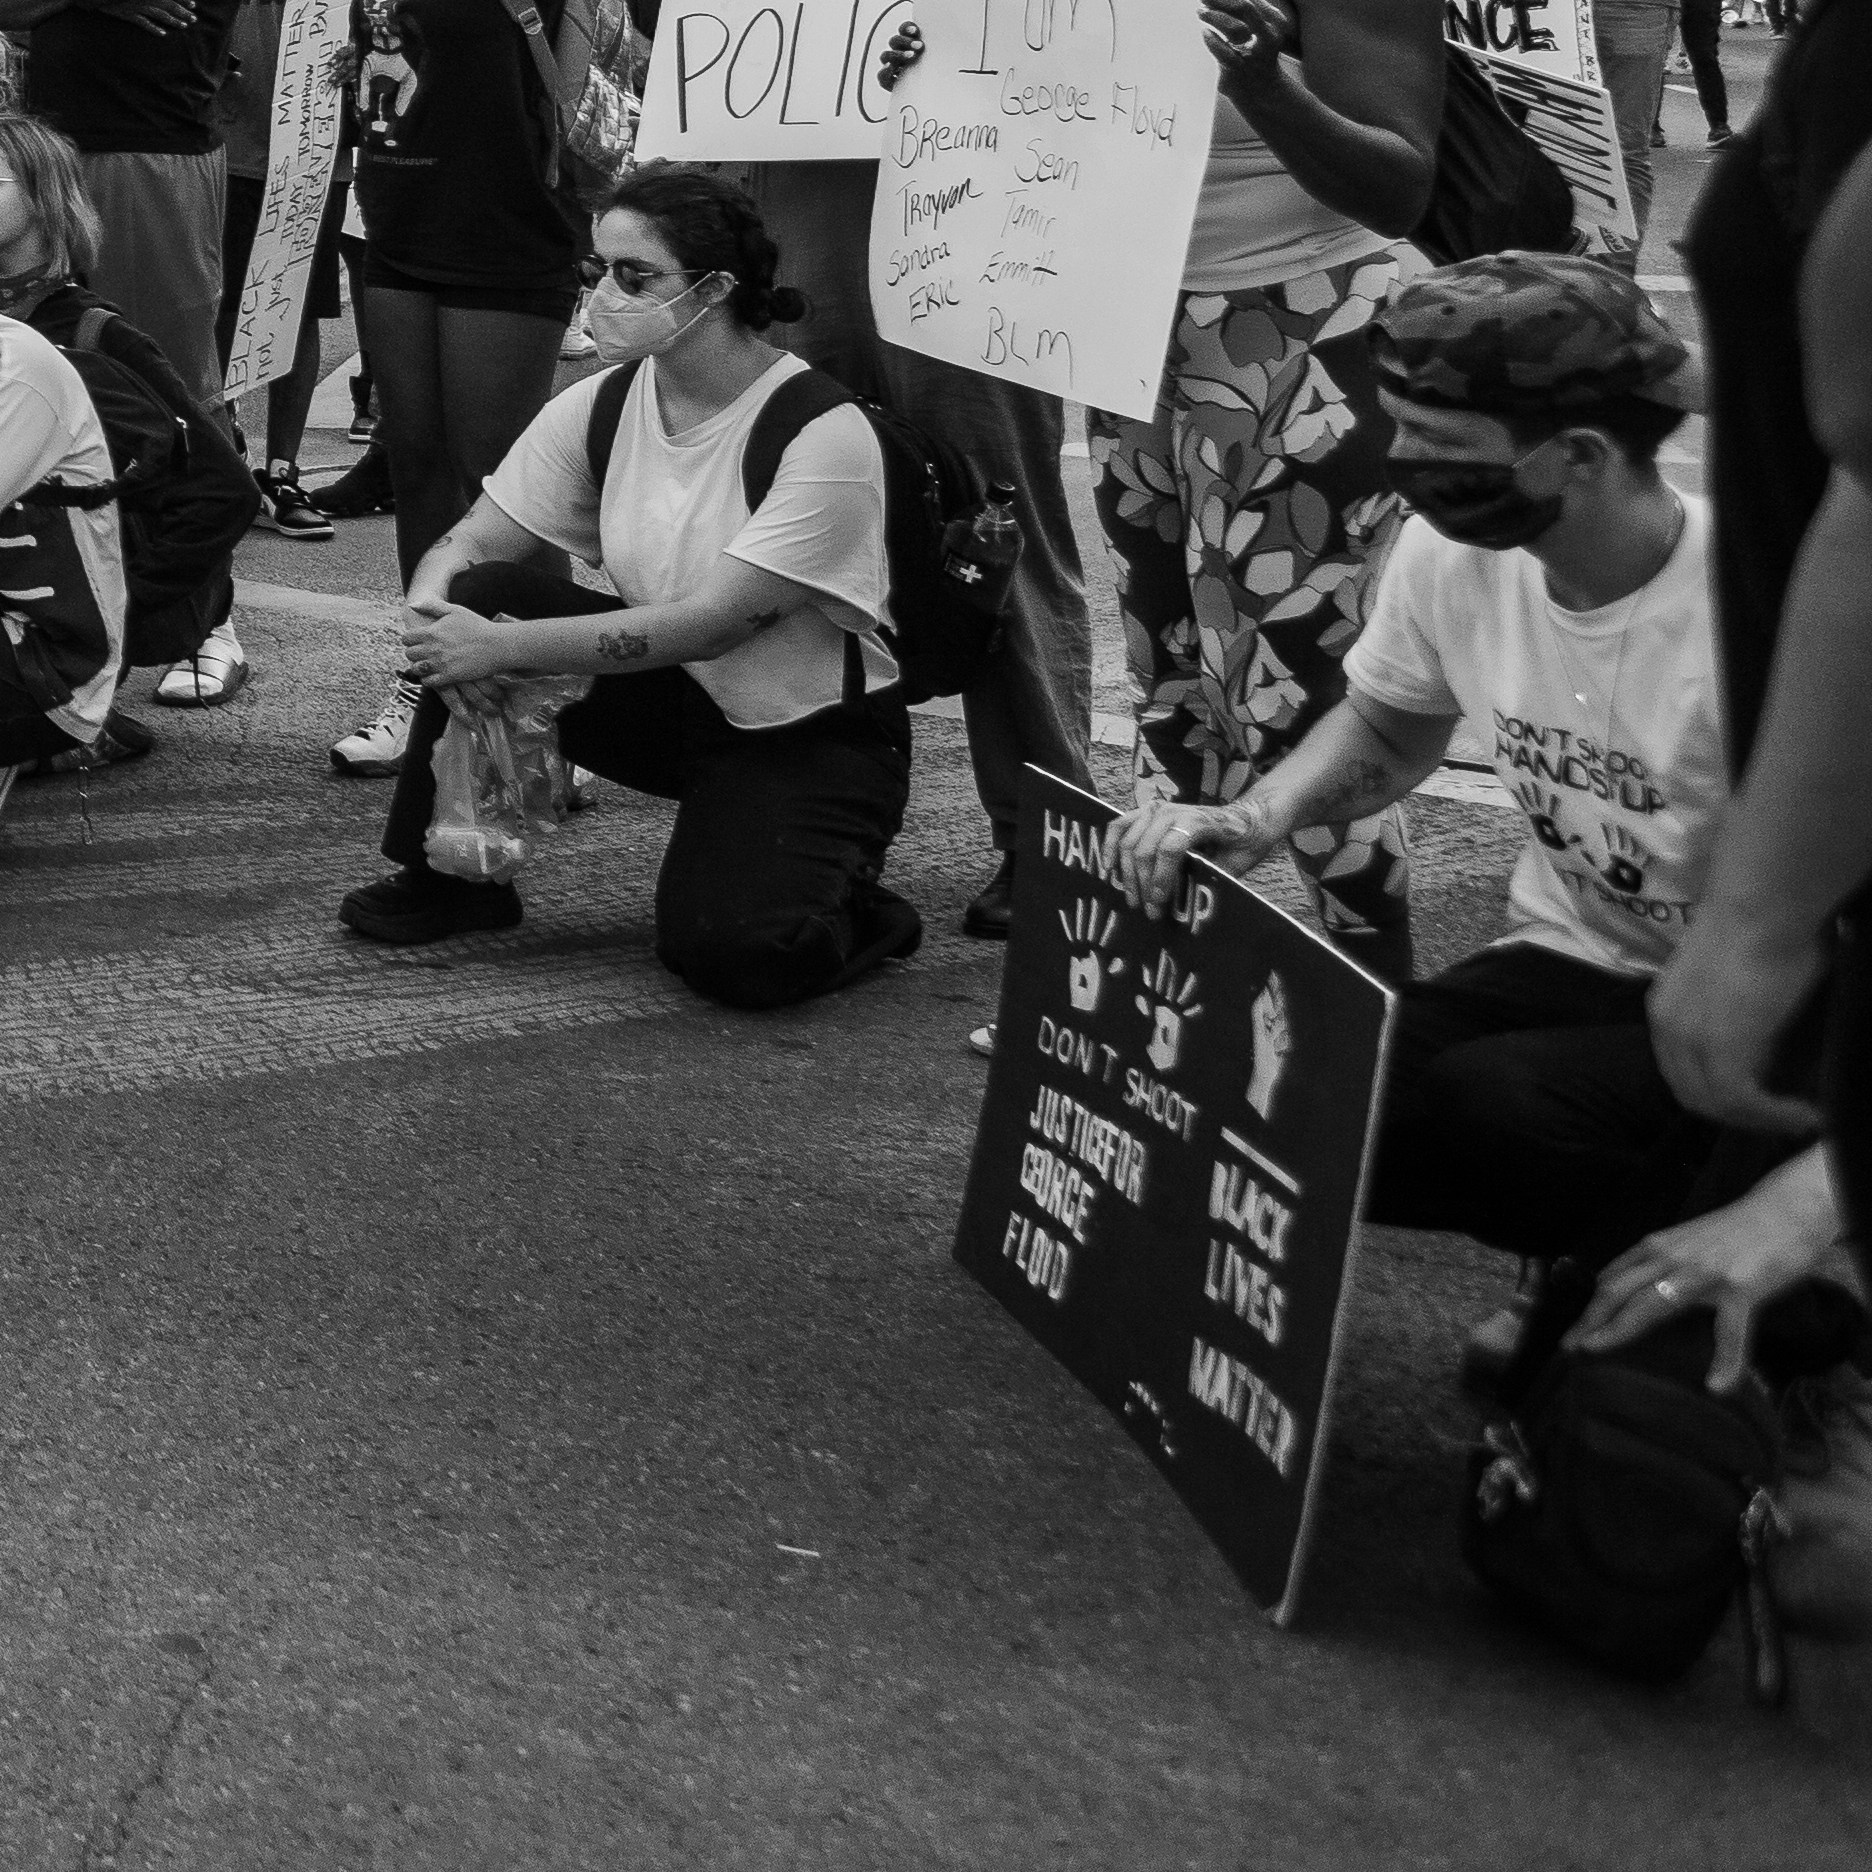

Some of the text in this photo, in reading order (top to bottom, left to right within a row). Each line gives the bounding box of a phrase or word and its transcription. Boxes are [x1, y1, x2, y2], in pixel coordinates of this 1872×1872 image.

[278, 182, 306, 246] TODAY
[296, 62, 315, 167] TOMORROW
[999, 66, 1177, 147] George Floyd
[224, 258, 274, 391] BLACK
[277, 1, 310, 126] MATTER
[1014, 137, 1080, 191] Sean
[885, 240, 952, 287] Sandra
[1493, 729, 1667, 815] HANDS UP
[1574, 737, 1647, 780] SHOO
[1043, 808, 1215, 935] HAN UP
[1122, 1066, 1200, 1144] SHOOT
[1020, 1142, 1098, 1246] GEORGE
[1208, 1159, 1293, 1262] BLACK
[1204, 1237, 1289, 1346] LIVES
[1187, 1335, 1298, 1478] MATTER
